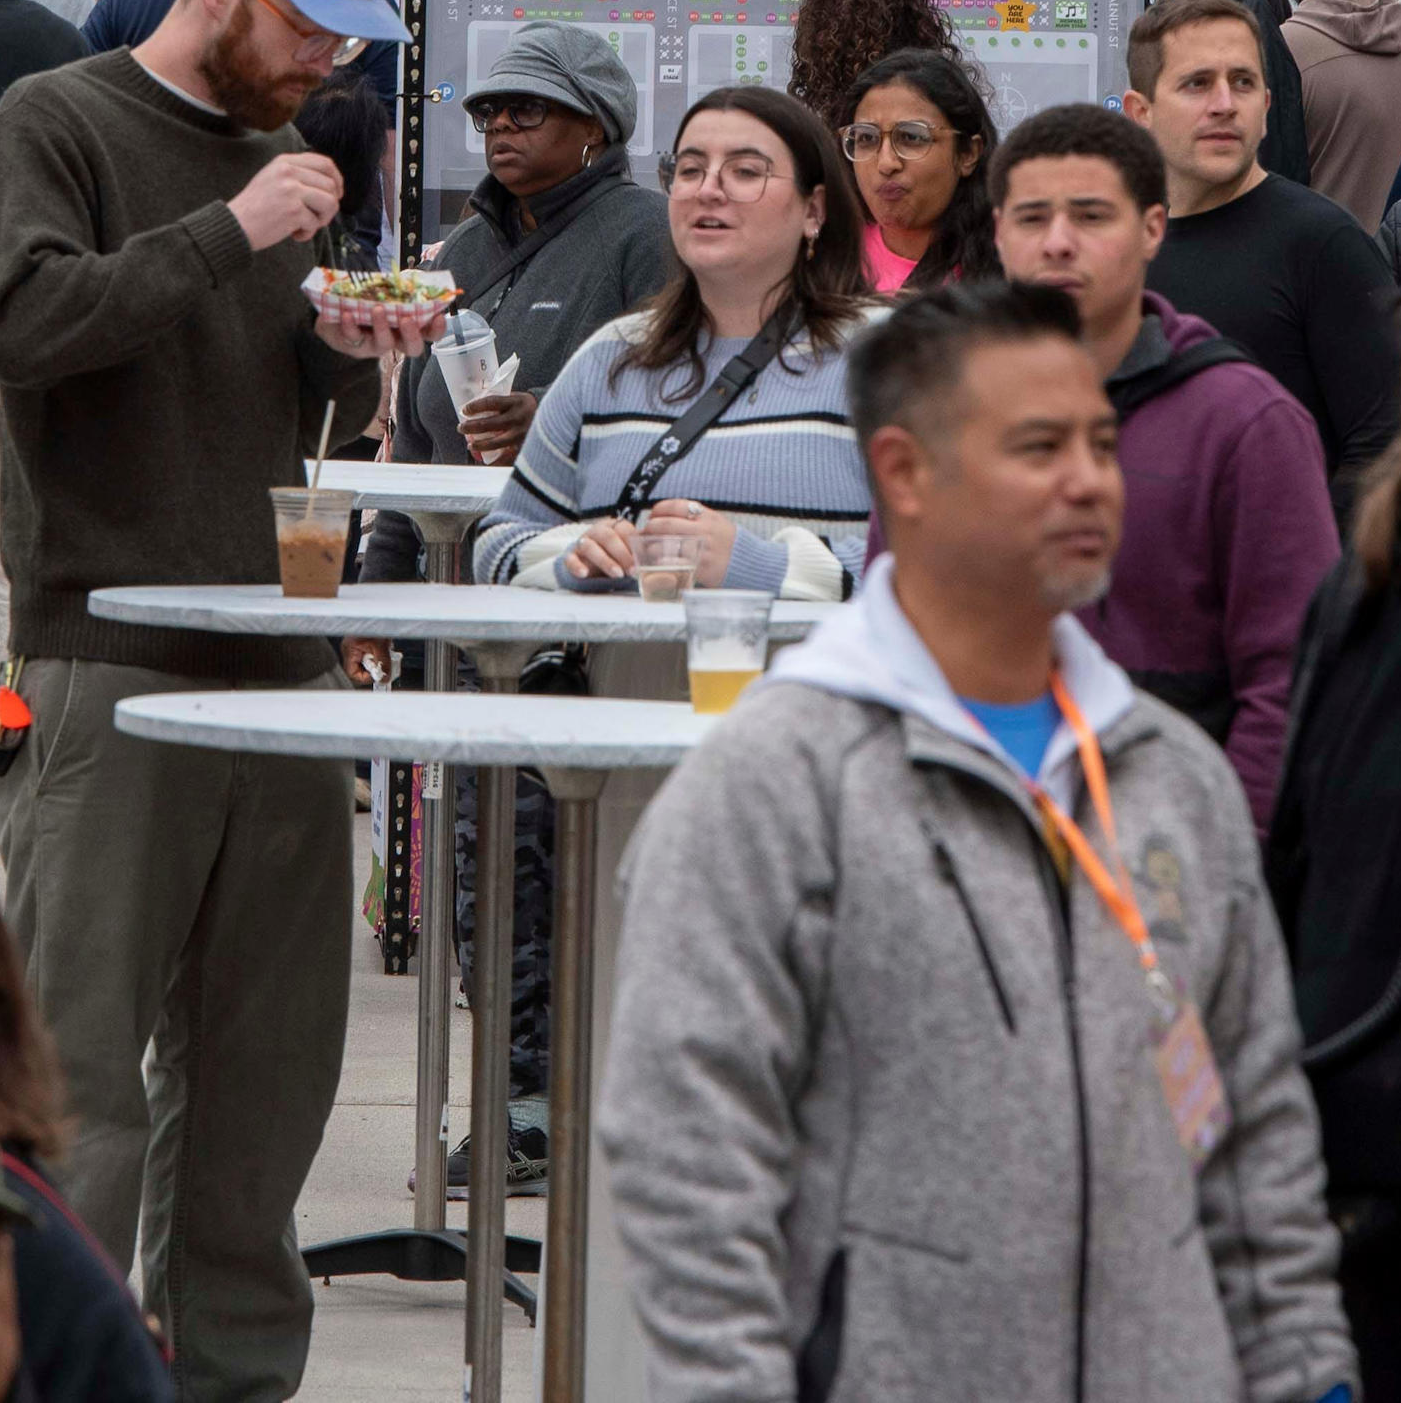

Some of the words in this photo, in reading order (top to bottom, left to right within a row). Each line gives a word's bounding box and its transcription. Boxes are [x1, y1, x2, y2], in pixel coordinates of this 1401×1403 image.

[448, 7, 458, 22] ST
[666, 16, 678, 29] ST
[1109, 35, 1119, 49] ST
